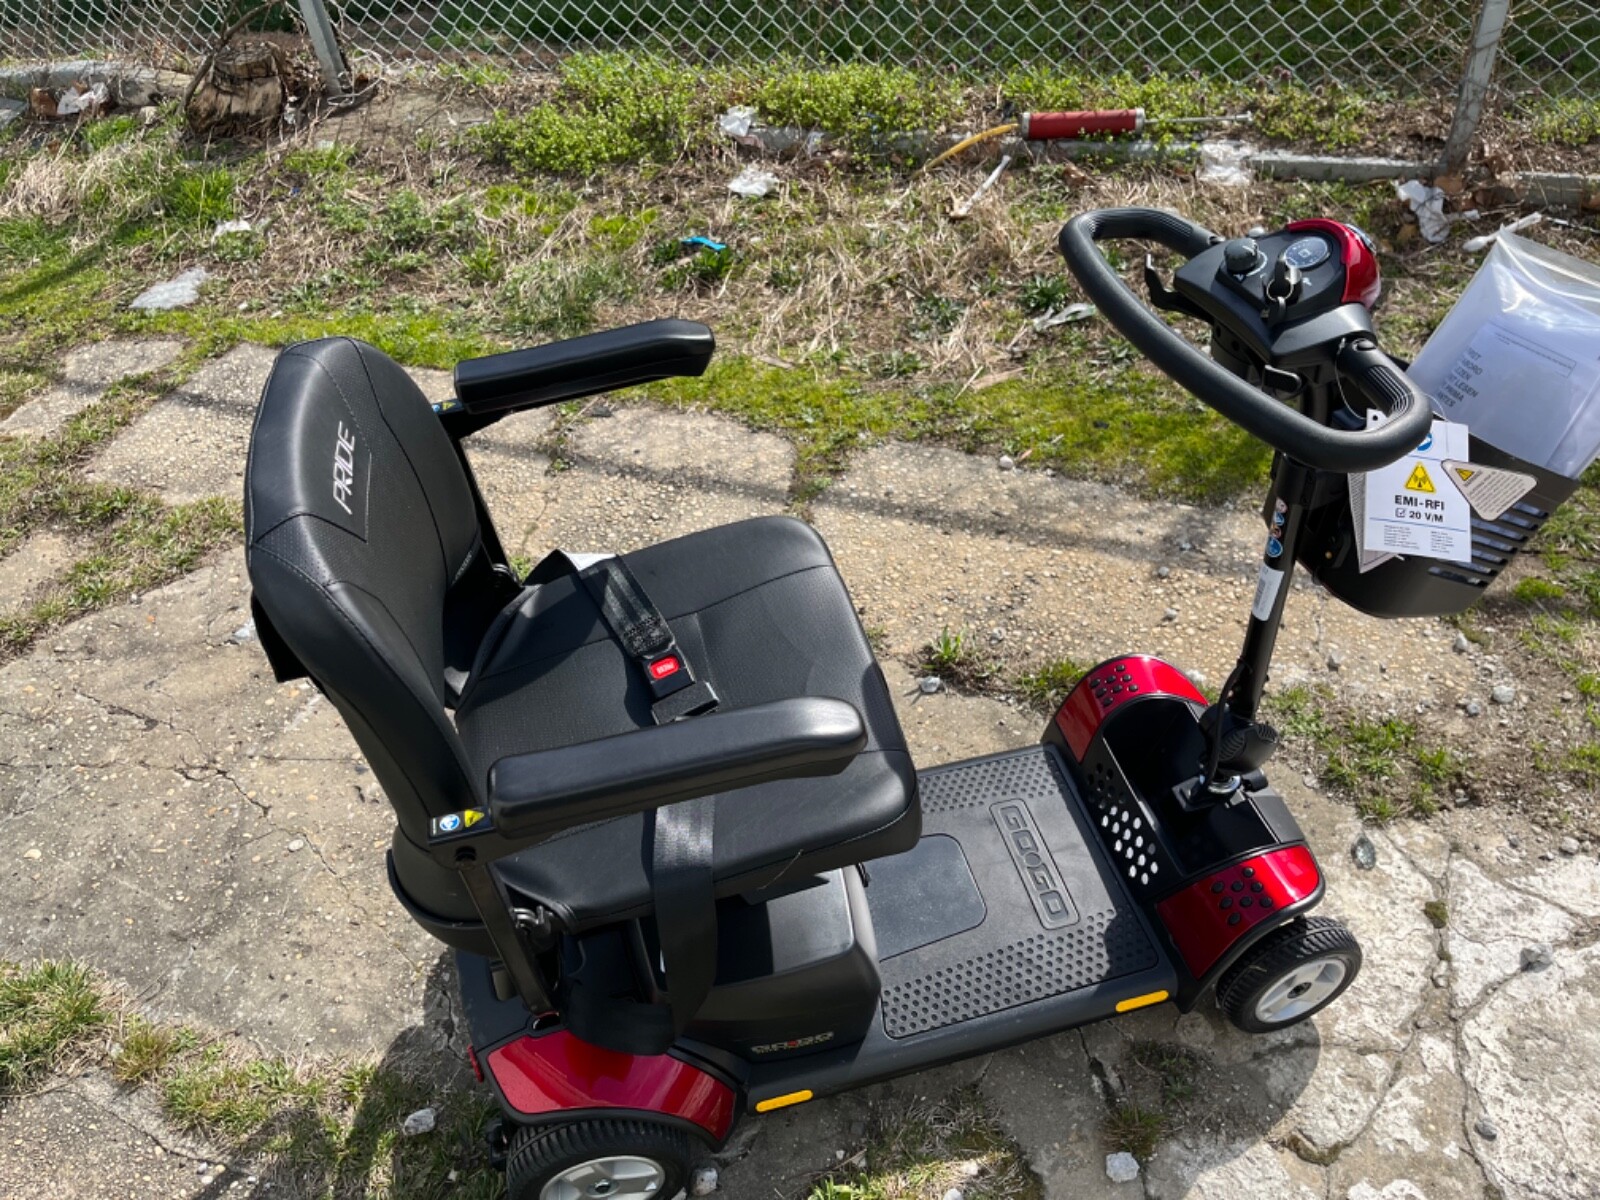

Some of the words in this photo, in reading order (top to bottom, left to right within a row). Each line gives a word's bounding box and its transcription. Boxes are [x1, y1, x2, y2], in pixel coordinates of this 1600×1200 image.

[333, 420, 355, 515] PRIDE
[1394, 494, 1445, 511] EMI-RFI
[1408, 510, 1422, 520] 20
[1424, 512, 1444, 523] V/M
